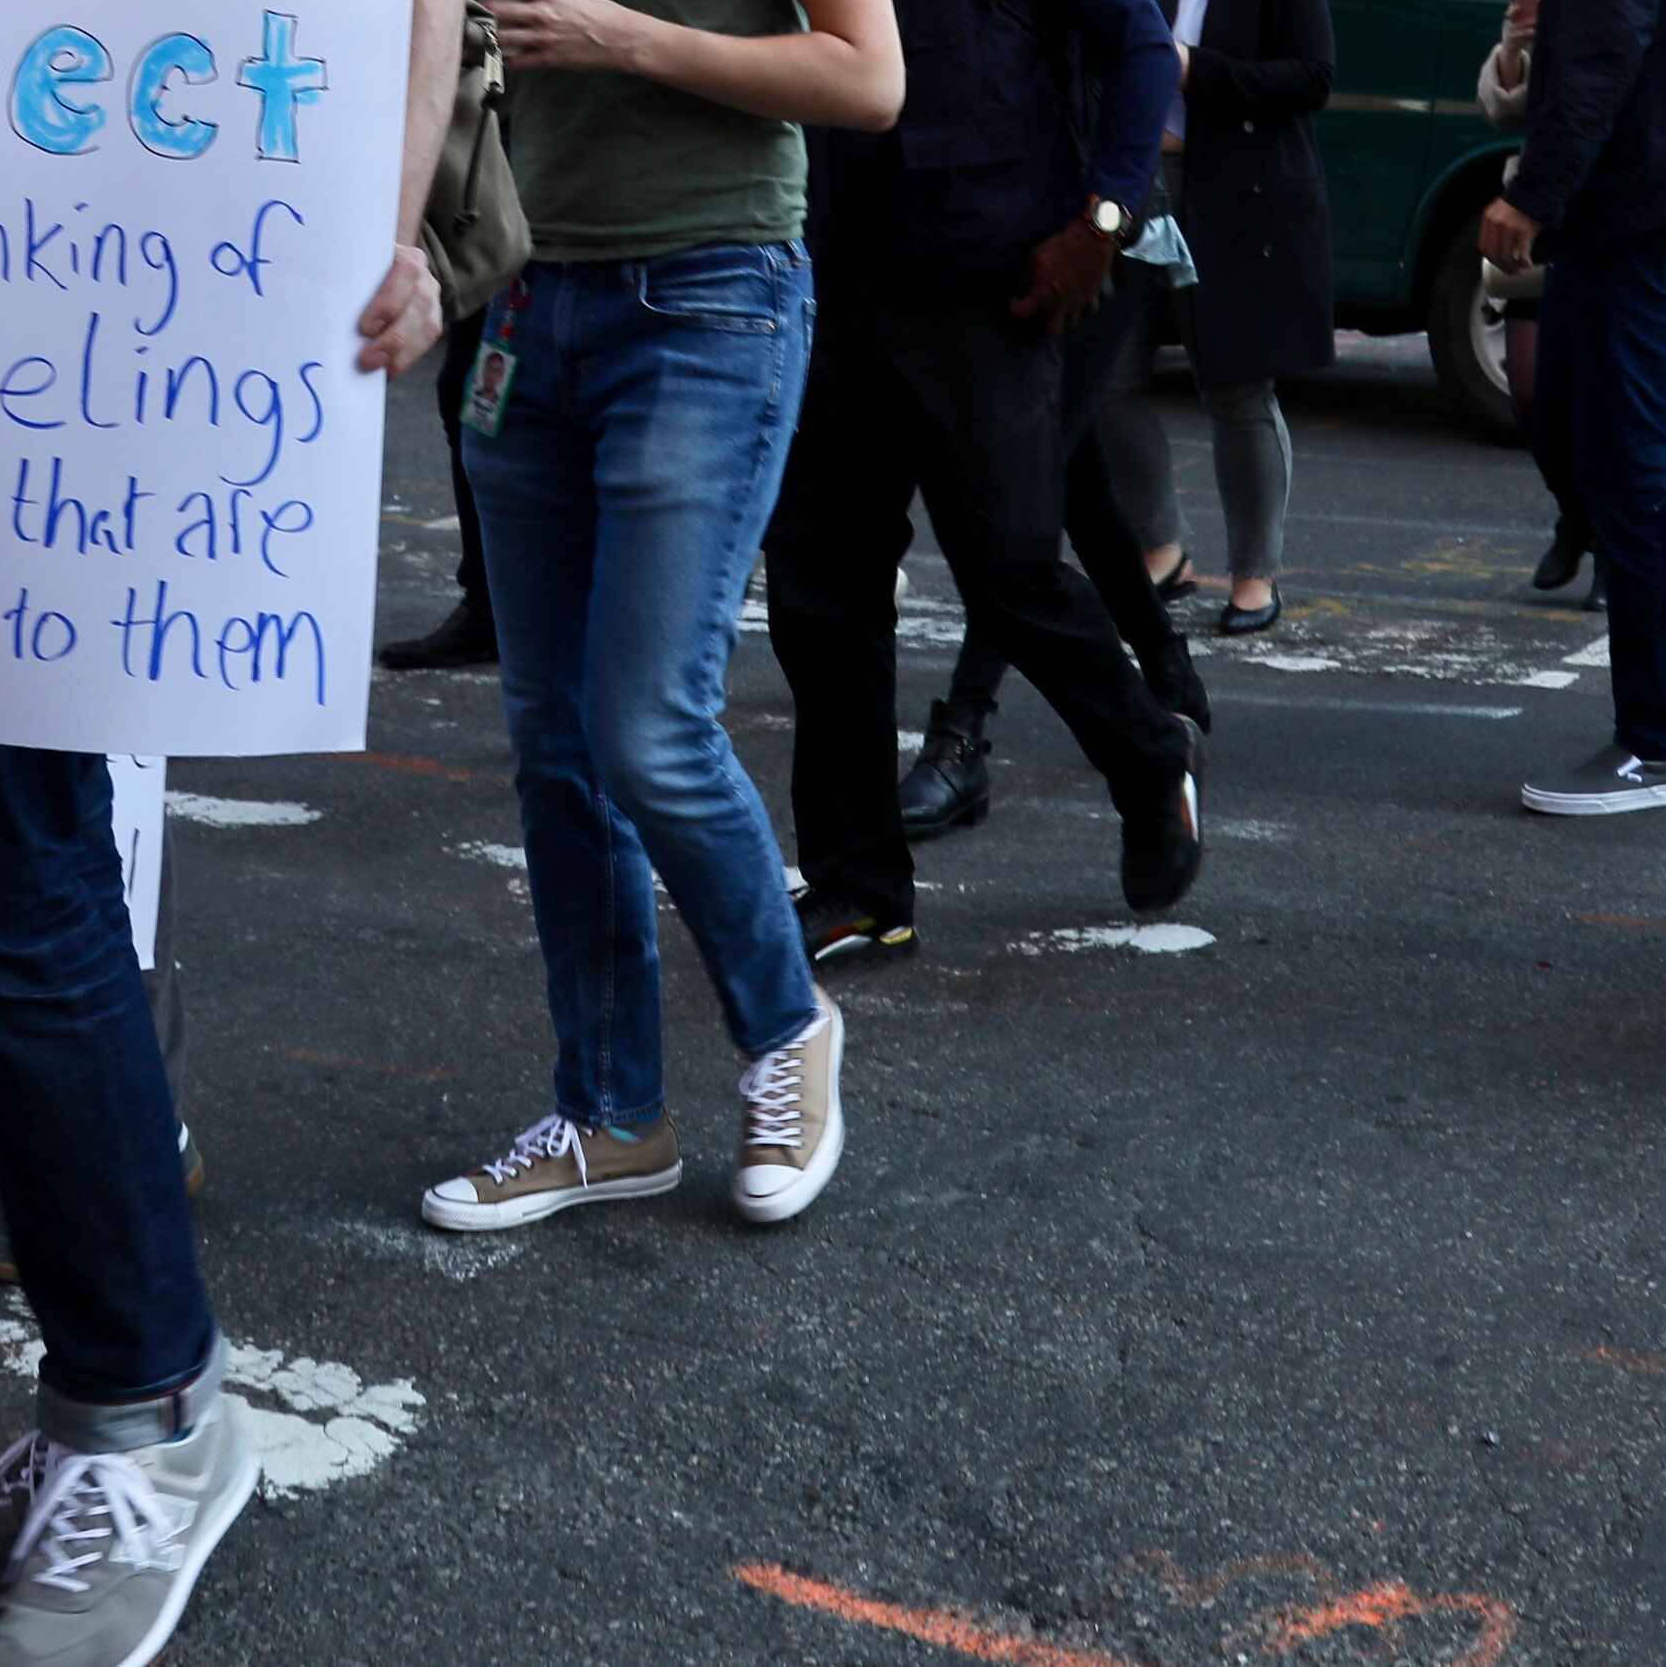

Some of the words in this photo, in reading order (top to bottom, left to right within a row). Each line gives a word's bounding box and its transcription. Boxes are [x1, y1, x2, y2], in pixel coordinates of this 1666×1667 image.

[209, 199, 304, 297] of
[13, 456, 159, 555] that
[176, 487, 314, 578] are
[2, 586, 79, 662] to
[110, 578, 328, 707] them
